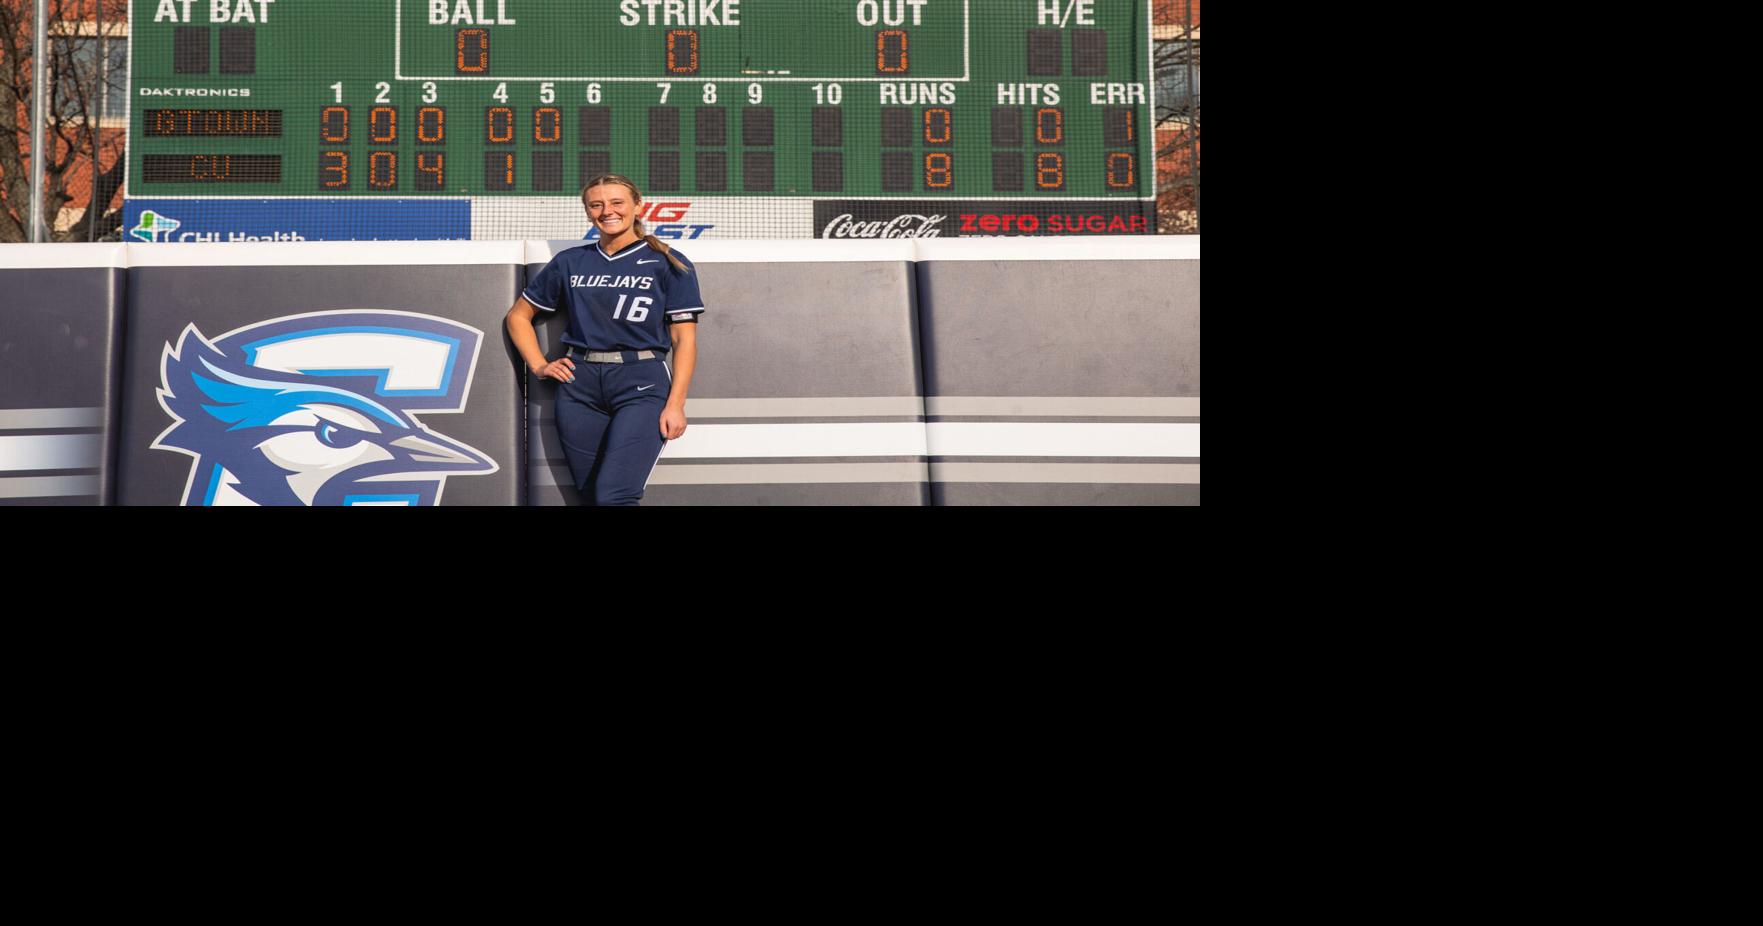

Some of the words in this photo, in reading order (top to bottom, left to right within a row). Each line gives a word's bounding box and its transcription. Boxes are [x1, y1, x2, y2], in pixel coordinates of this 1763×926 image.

[153, 0, 198, 23] AT
[209, 0, 276, 24] BAT
[428, 0, 516, 25] BALL
[619, 0, 740, 27] STRIKE
[856, 0, 928, 27] OUT
[1037, 0, 1095, 28] H/E
[457, 29, 487, 72] 0
[667, 29, 698, 73] 0
[877, 30, 908, 73] 0
[139, 87, 250, 97] DAKTRONICS
[330, 82, 342, 103] 1
[375, 82, 391, 103] 2
[421, 82, 438, 103] 3
[492, 82, 509, 103] 4
[539, 82, 555, 104] 5
[586, 82, 602, 104] 6
[656, 82, 672, 104] 7
[702, 82, 717, 104] 8
[747, 83, 763, 104] 9
[811, 83, 843, 105] 10
[879, 83, 956, 105] RUNS
[997, 83, 1061, 105] HITS
[1090, 83, 1146, 105] ERR
[323, 107, 348, 142] 0
[370, 107, 396, 142] 0
[418, 107, 443, 142] 0
[489, 108, 512, 142] 0
[535, 108, 560, 142] 0
[925, 108, 950, 143] 0
[1037, 109, 1061, 143] 0
[191, 155, 231, 180] CU
[325, 152, 348, 186] 3
[370, 152, 395, 186] 0
[418, 154, 443, 184] 4
[926, 153, 951, 187] 8
[1037, 153, 1062, 187] 8
[1108, 153, 1133, 187] 0
[959, 213, 1040, 233] zero
[1047, 214, 1148, 233] SUGAR
[570, 274, 654, 290] BLUEJAYS
[612, 294, 654, 323] 16
